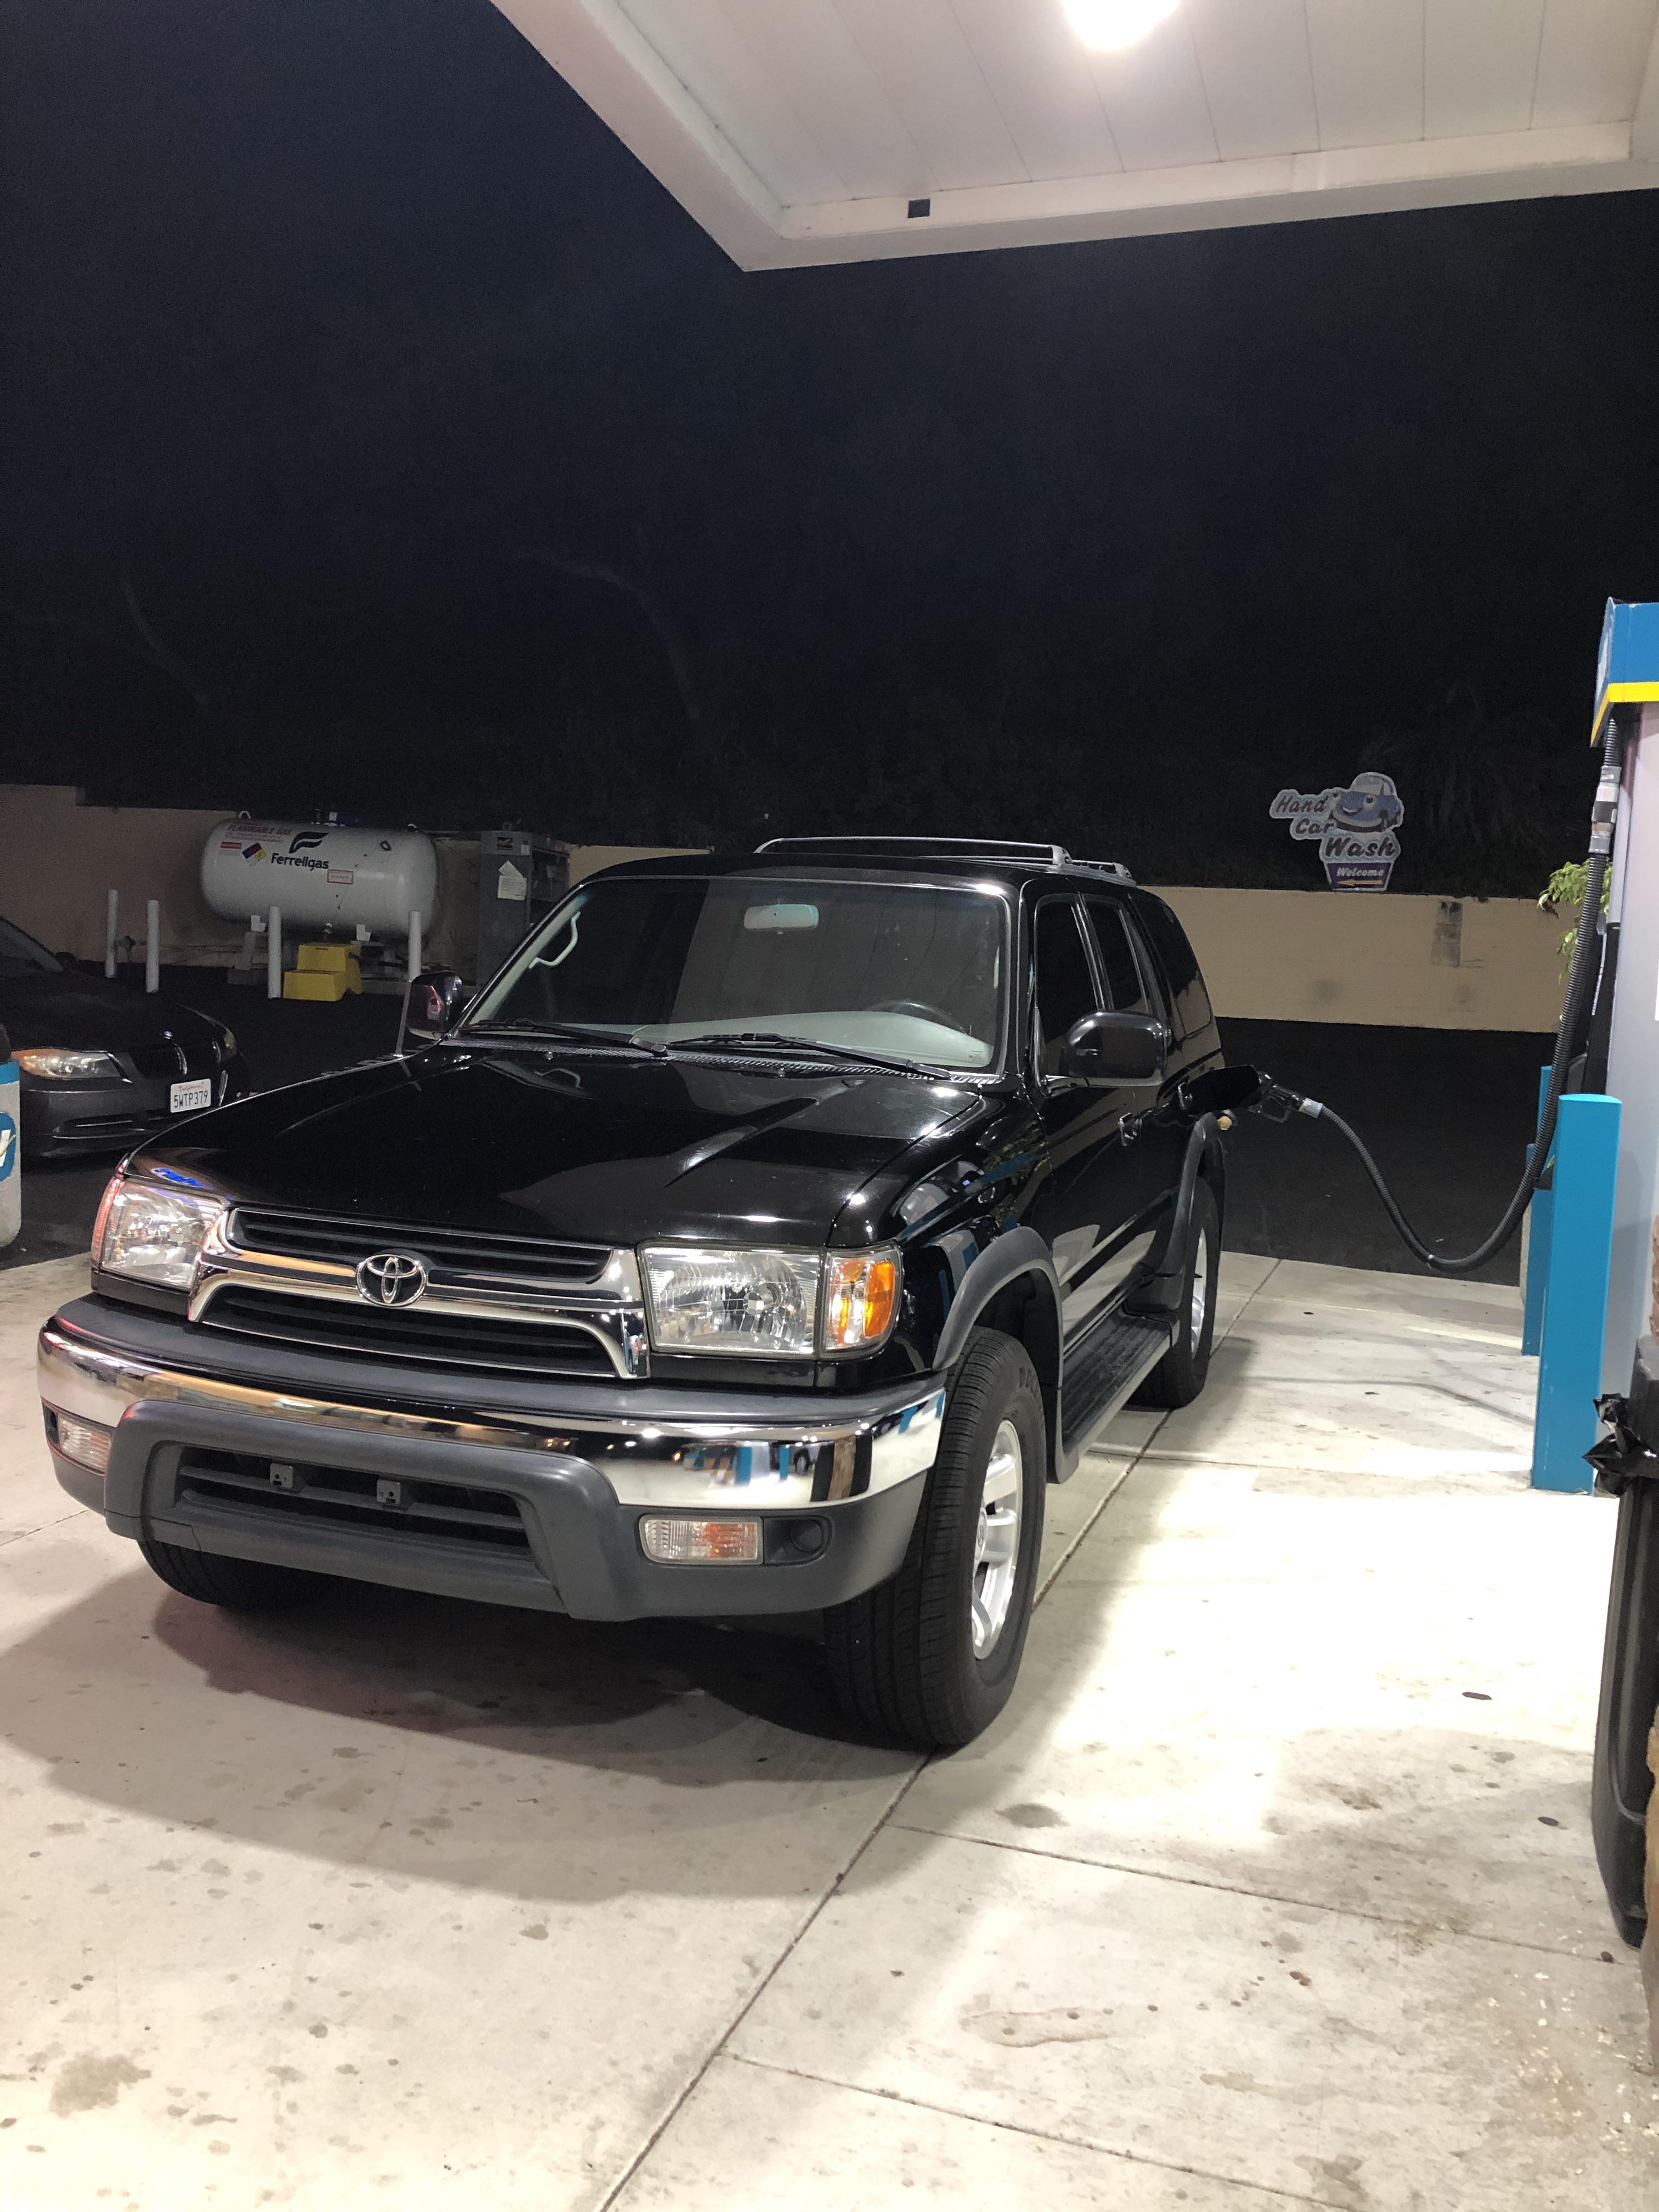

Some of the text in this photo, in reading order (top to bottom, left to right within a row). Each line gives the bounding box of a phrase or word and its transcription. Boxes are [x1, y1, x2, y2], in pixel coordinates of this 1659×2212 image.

[1276, 794, 1329, 812] Hand
[227, 823, 275, 834] FLAMMABLE
[1295, 818, 1334, 834] Car
[1325, 837, 1395, 857] Wash
[271, 853, 329, 871] Ferrellgas
[1336, 867, 1384, 876] Welcome
[174, 1090, 208, 1108] 5WTP379
